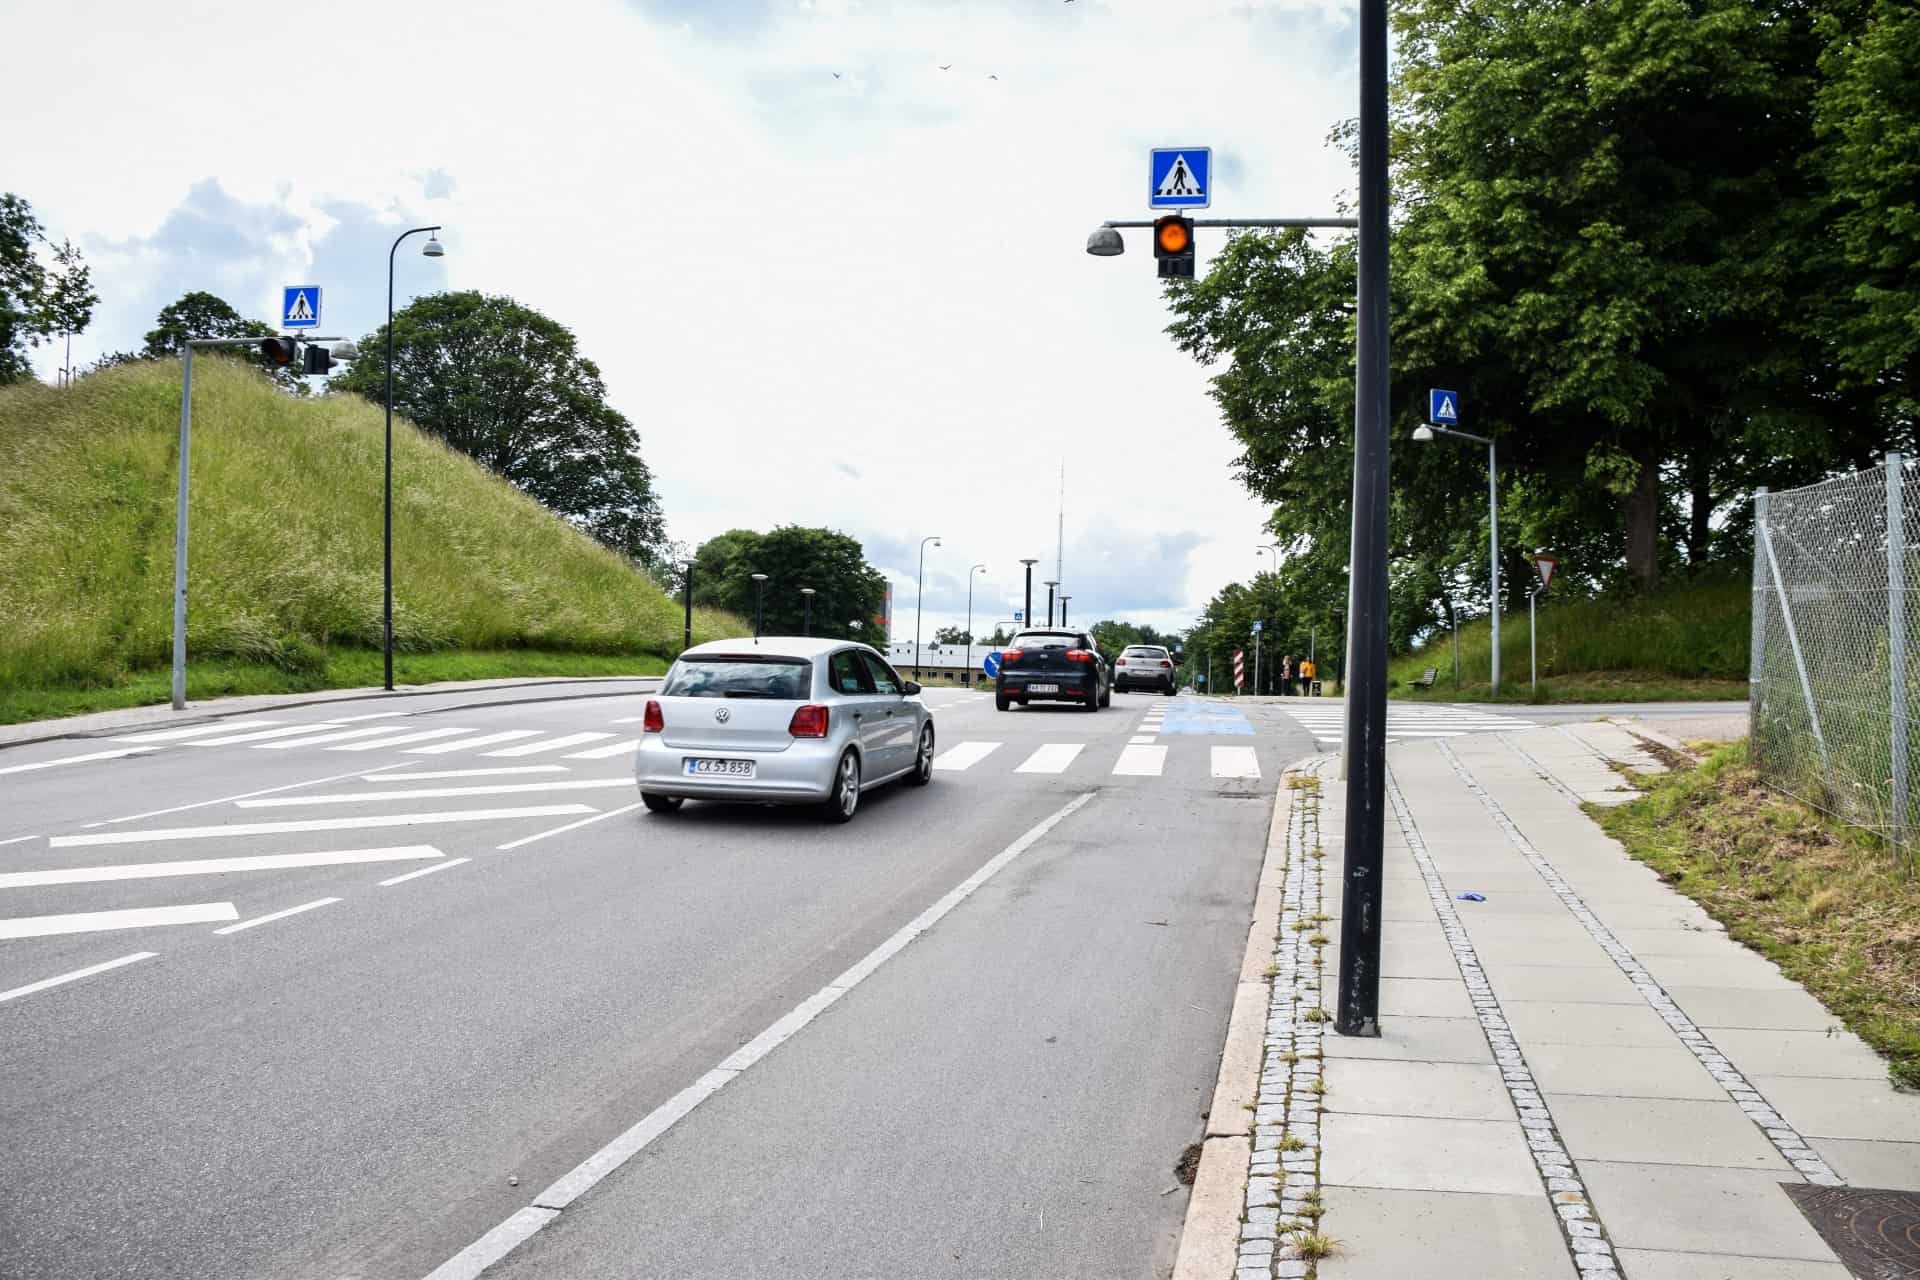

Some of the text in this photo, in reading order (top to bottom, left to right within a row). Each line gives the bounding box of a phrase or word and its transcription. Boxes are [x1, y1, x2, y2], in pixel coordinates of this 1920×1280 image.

[697, 760, 751, 774] CX 53 858
